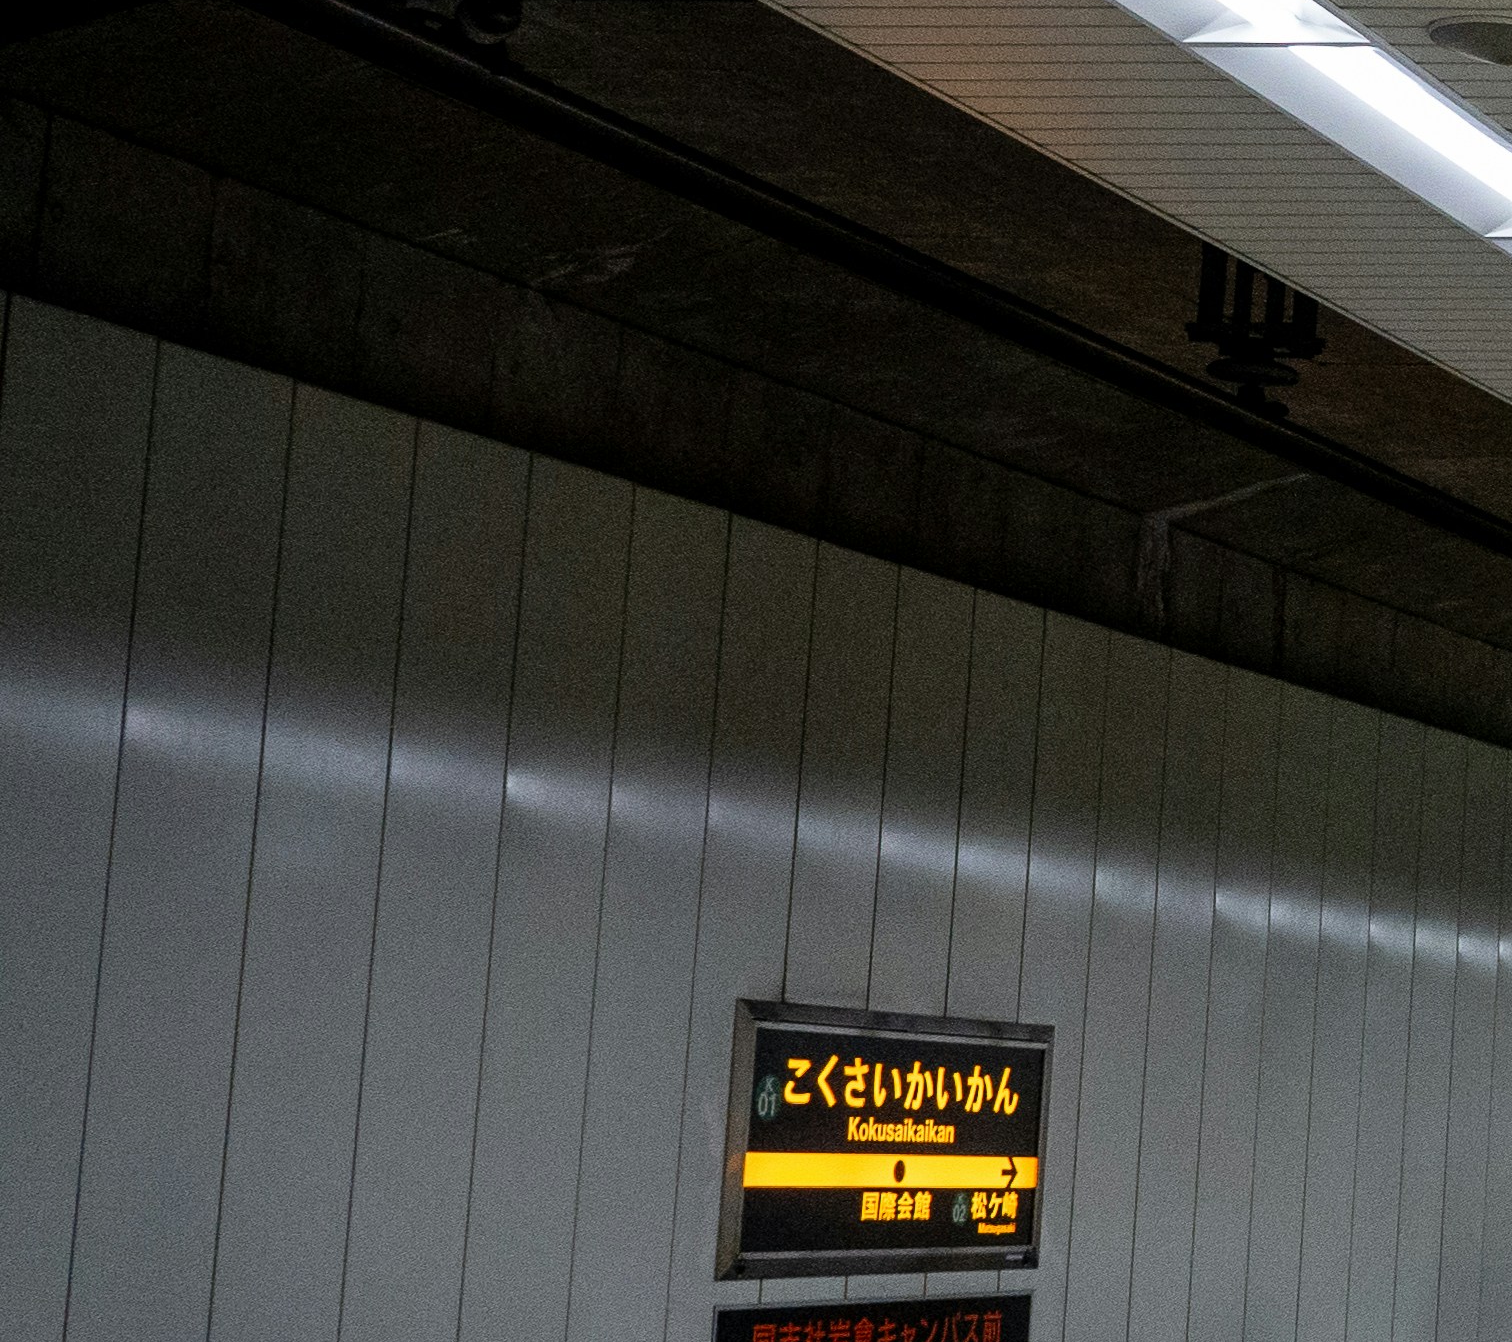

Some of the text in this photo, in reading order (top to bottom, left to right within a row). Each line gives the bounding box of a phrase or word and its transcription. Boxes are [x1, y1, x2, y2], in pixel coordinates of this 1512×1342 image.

[783, 1055, 1020, 1115] こくさいかいかん
[847, 1117, 955, 1143] Kokusaikaikan
[861, 1192, 932, 1221] 国際会館
